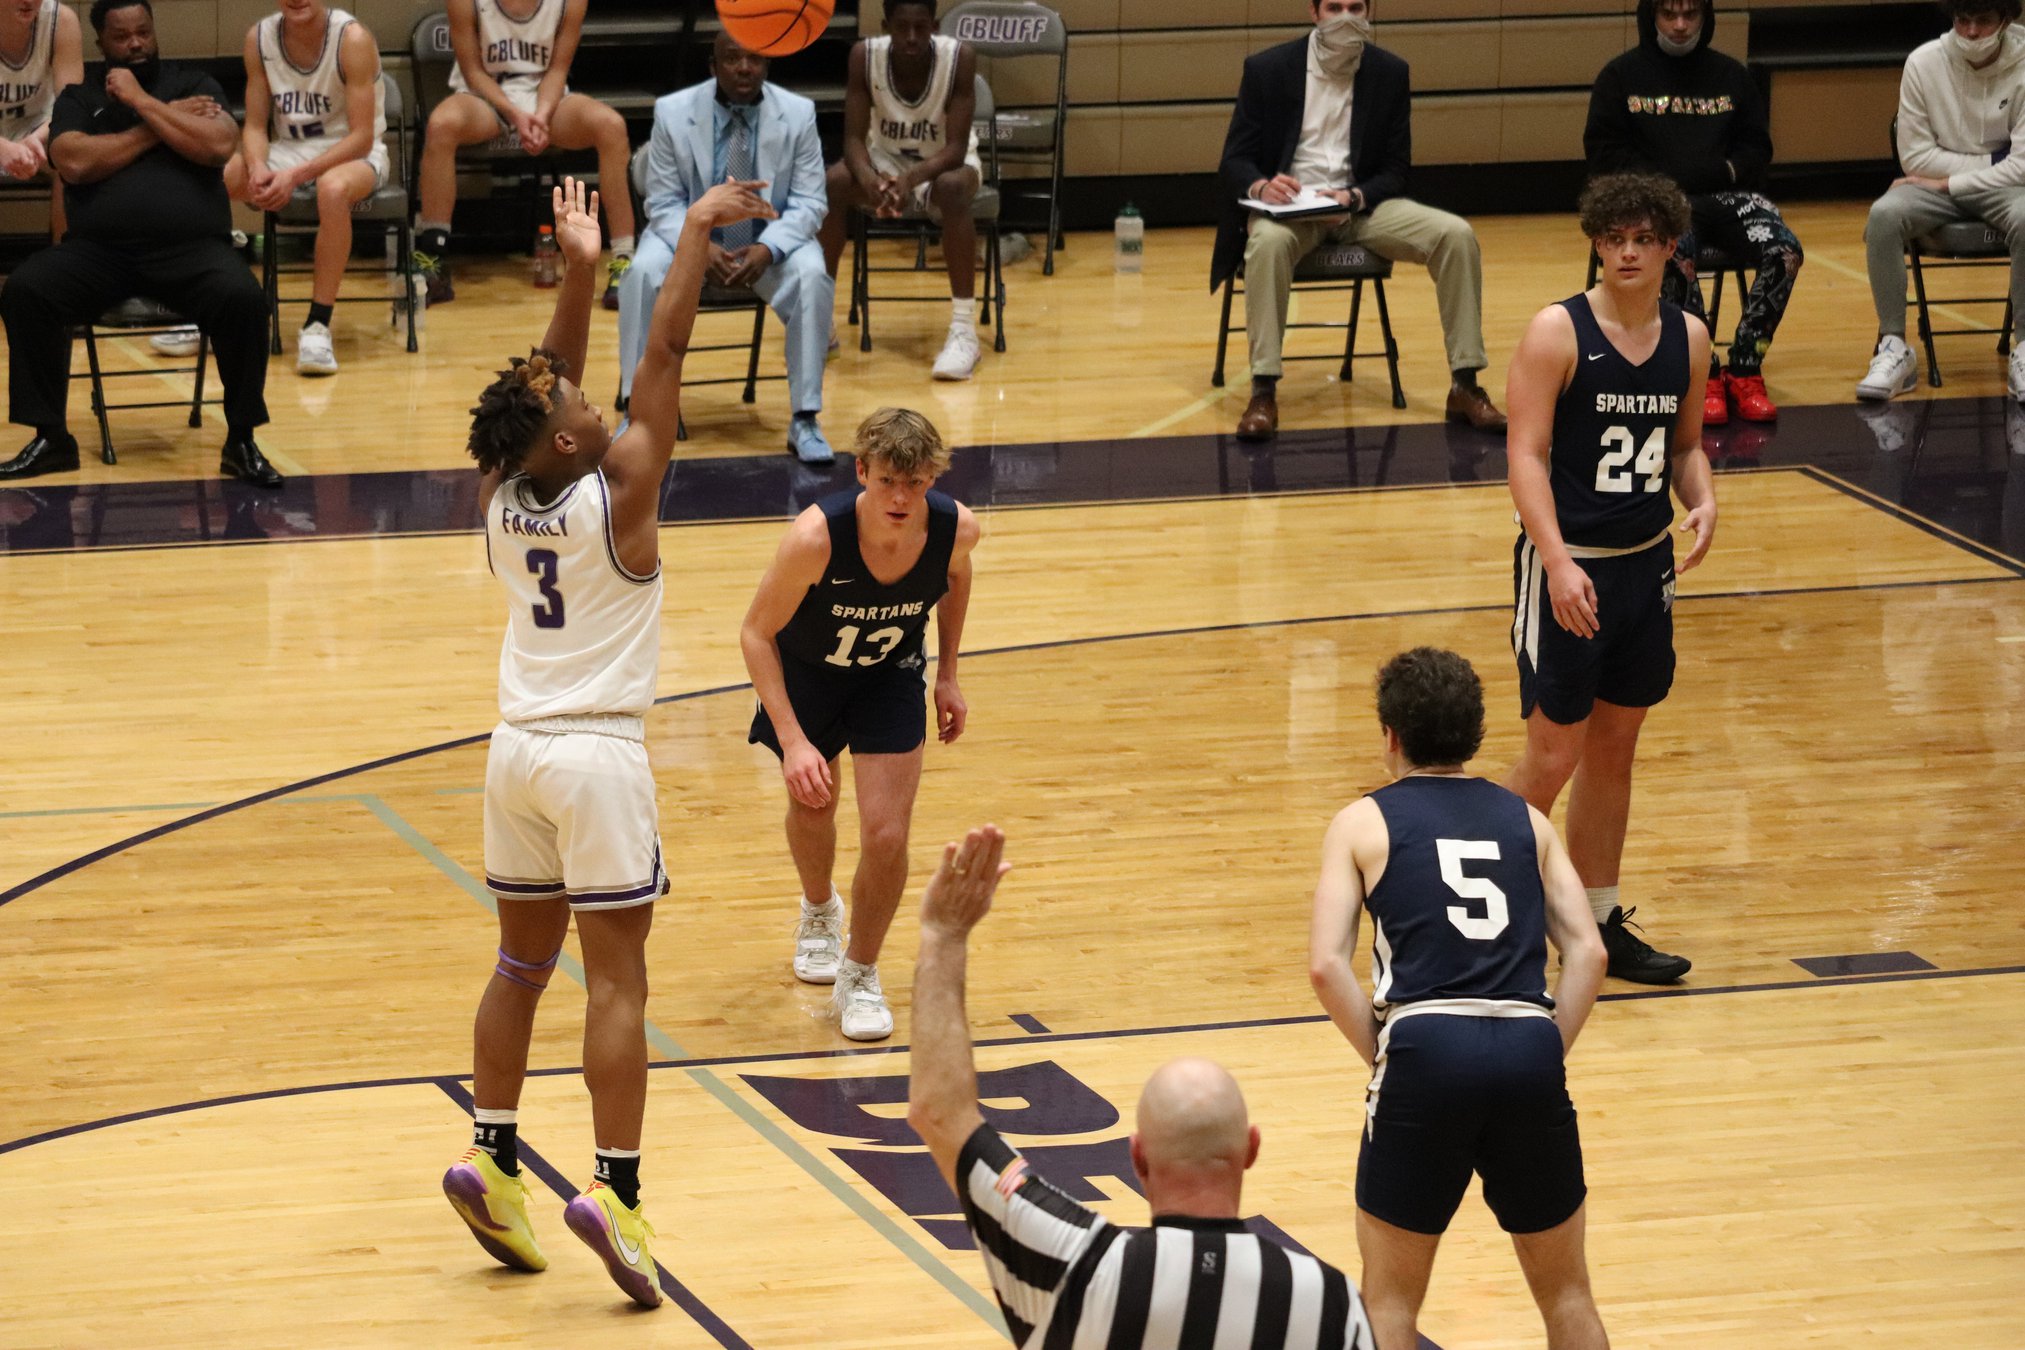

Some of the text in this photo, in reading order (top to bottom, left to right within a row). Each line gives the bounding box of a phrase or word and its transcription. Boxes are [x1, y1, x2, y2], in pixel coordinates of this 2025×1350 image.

[957, 14, 1048, 43] CBLUFF
[487, 38, 549, 66] CBLUFF
[272, 90, 332, 115] CBLUFF
[880, 118, 938, 141] CBLUFF
[1596, 393, 1678, 414] SPARTANS
[1595, 425, 1666, 493] 24
[502, 507, 568, 537] FAMILY
[526, 548, 565, 629] 3
[832, 601, 924, 621] SPARTANS
[824, 625, 904, 667] 13
[1435, 838, 1510, 940] 5
